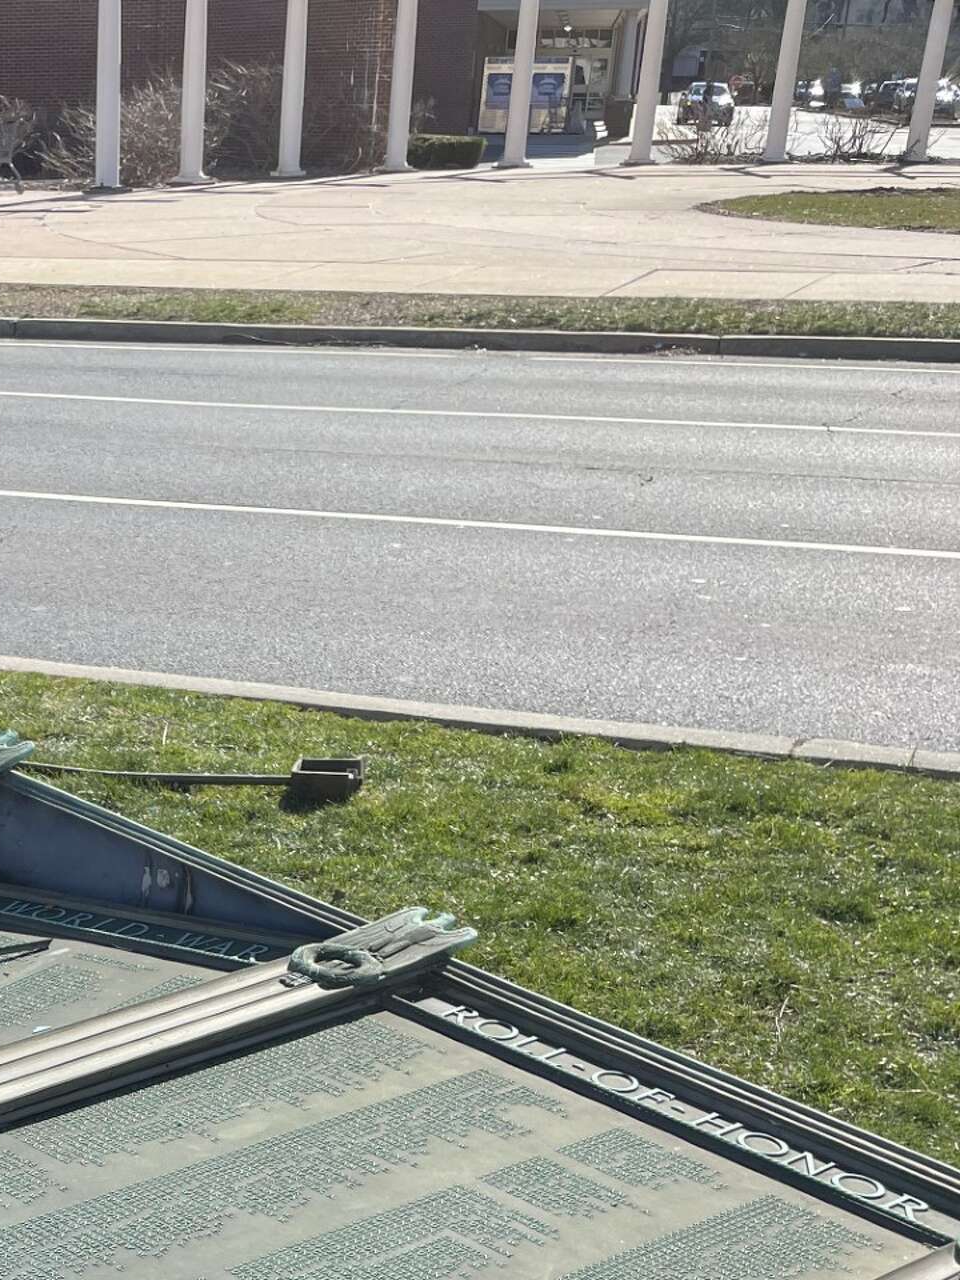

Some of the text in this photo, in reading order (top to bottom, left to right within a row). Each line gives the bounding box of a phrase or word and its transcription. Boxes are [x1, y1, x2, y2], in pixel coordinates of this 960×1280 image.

[1, 900, 149, 938] WORLD
[175, 931, 271, 962] WAR
[693, 1111, 929, 1224] HONOR
